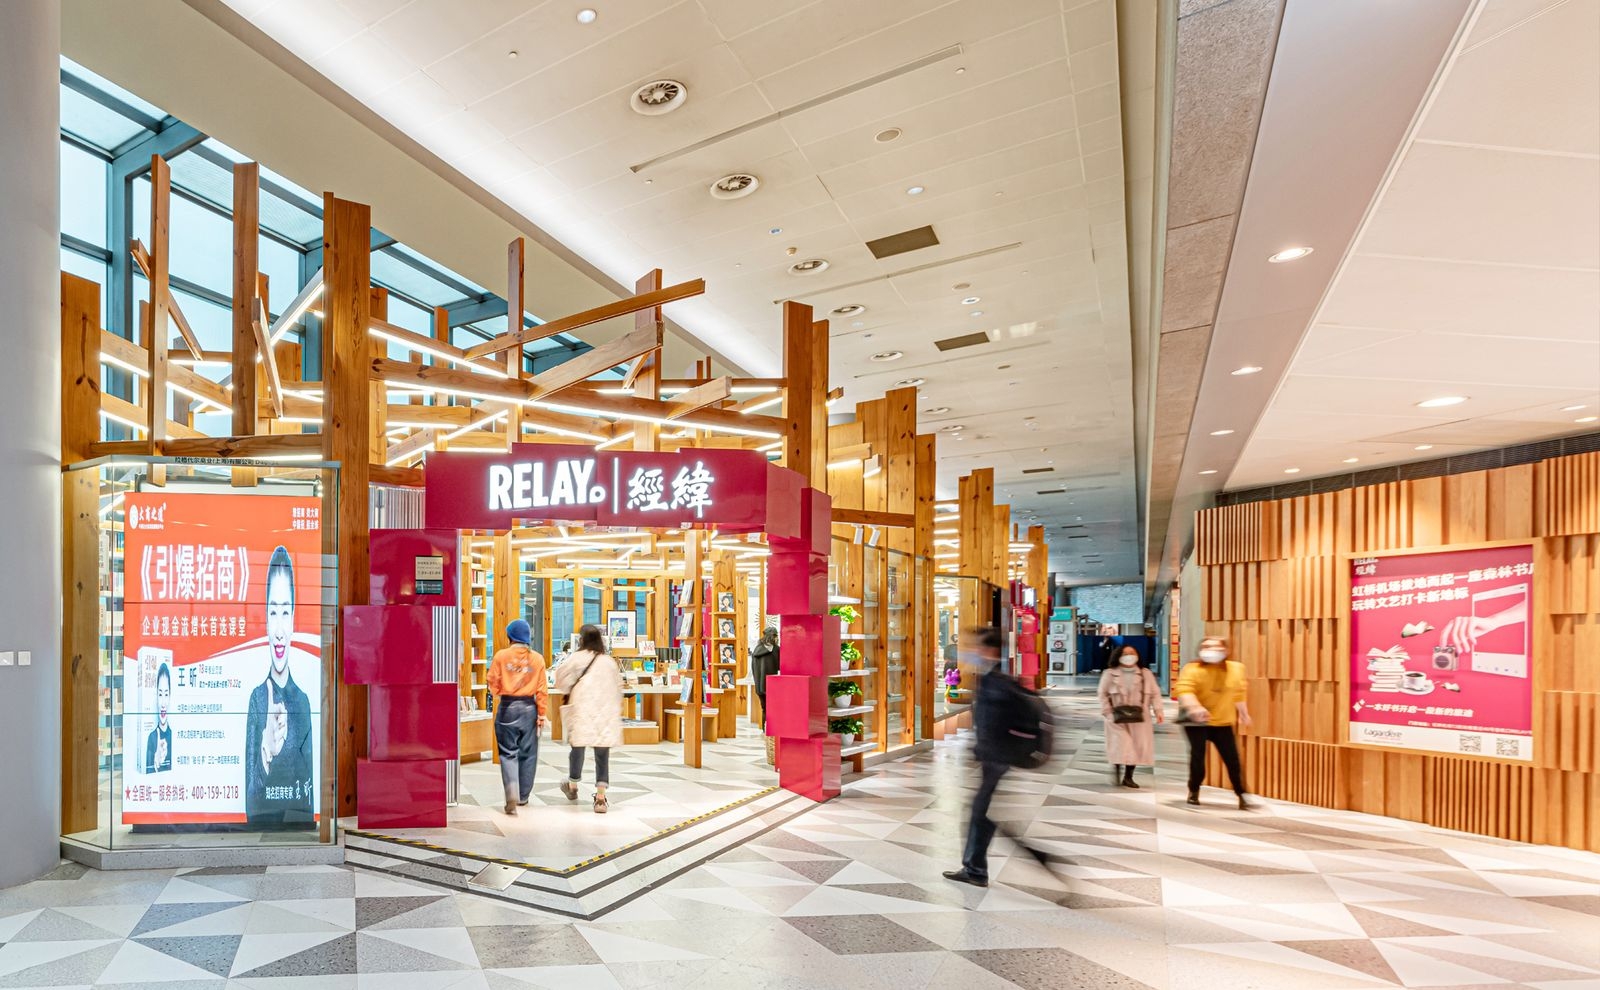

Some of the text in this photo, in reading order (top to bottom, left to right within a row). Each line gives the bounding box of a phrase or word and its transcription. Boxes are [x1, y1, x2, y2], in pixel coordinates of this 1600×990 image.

[627, 461, 715, 518] 經緯
[141, 544, 249, 602] 《引爆招商》
[1352, 587, 1469, 612] 玩转文艺打卡新地标
[142, 616, 246, 636] 企业现金流增长首选课堂
[192, 785, 239, 799] 400-159-1218
